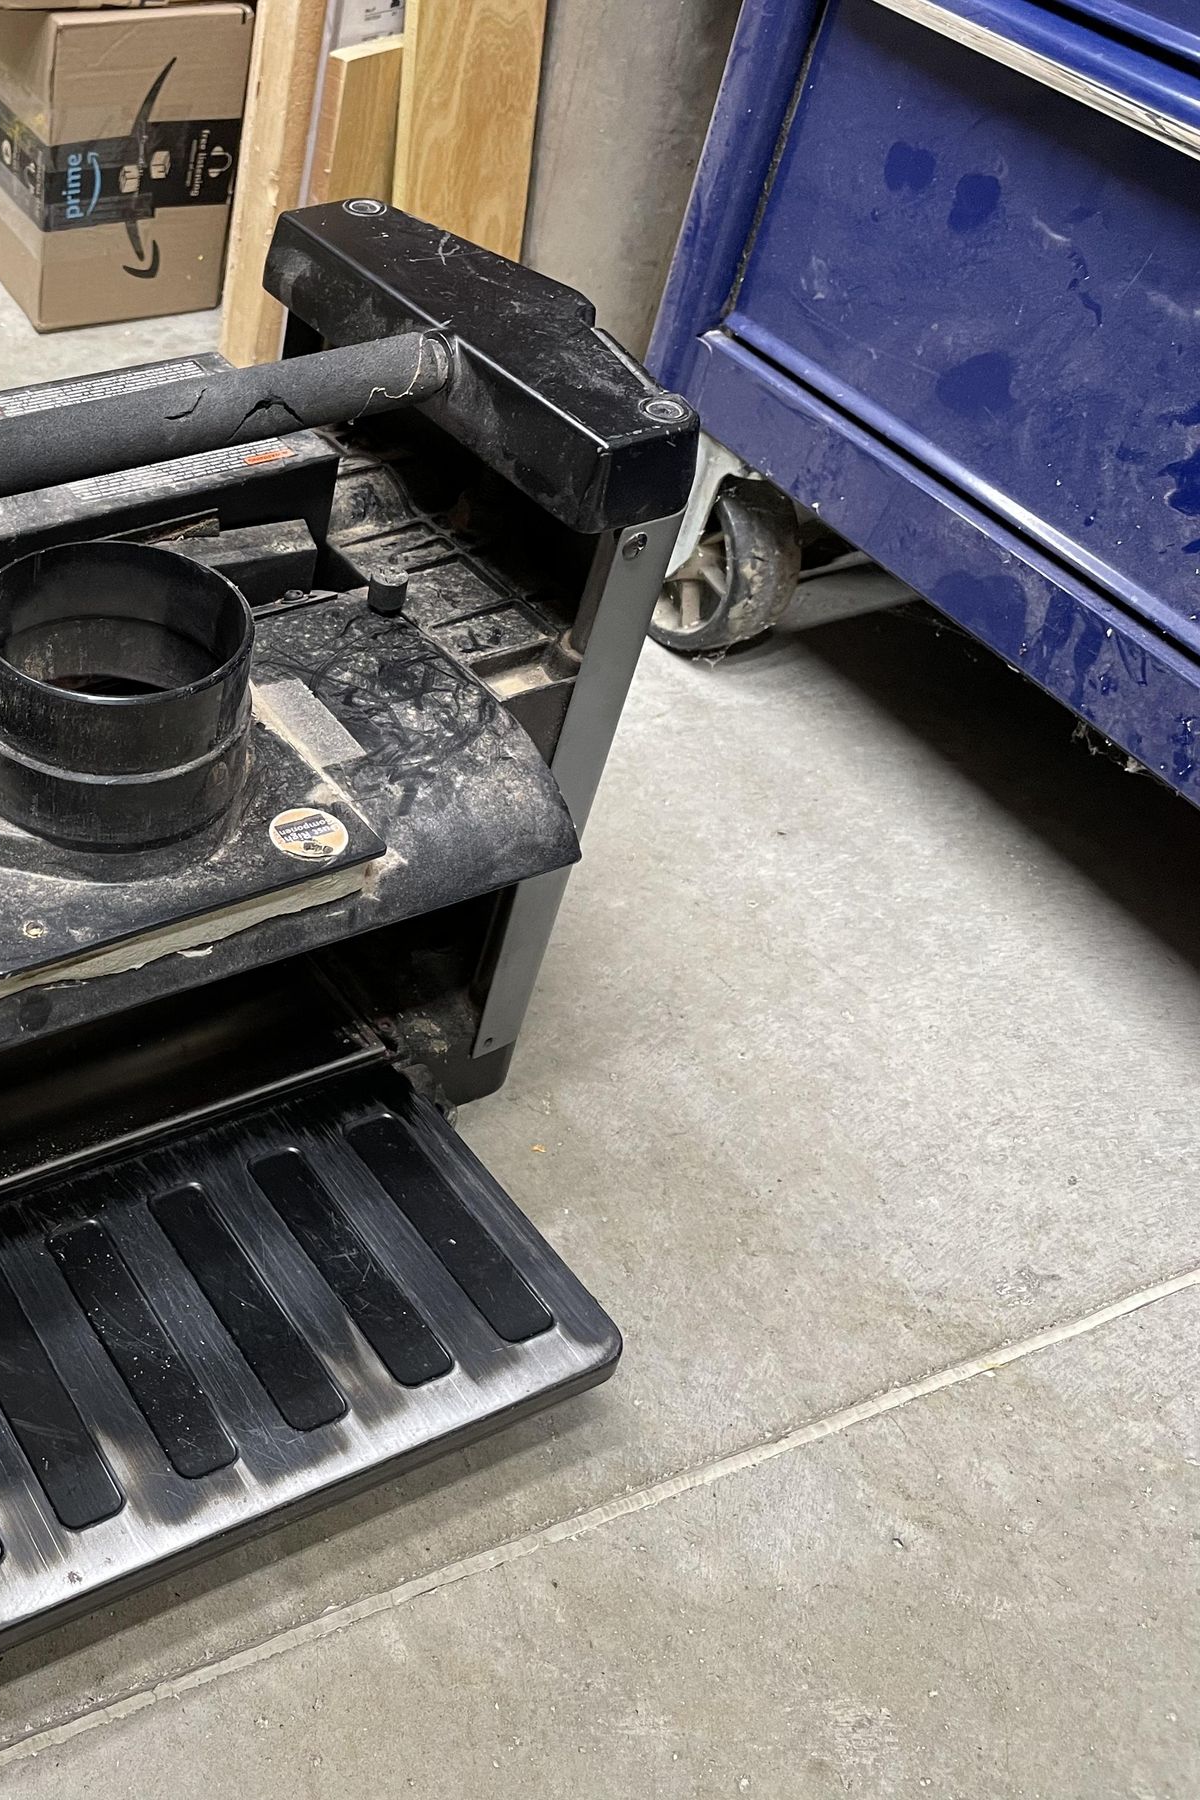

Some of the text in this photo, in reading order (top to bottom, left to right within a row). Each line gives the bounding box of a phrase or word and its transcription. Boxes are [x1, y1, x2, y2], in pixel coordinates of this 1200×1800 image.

[200, 129, 211, 151] free
[190, 152, 208, 197] listening
[61, 153, 84, 219] prime
[276, 818, 333, 837] omponen
[280, 823, 339, 843] ust Righ
